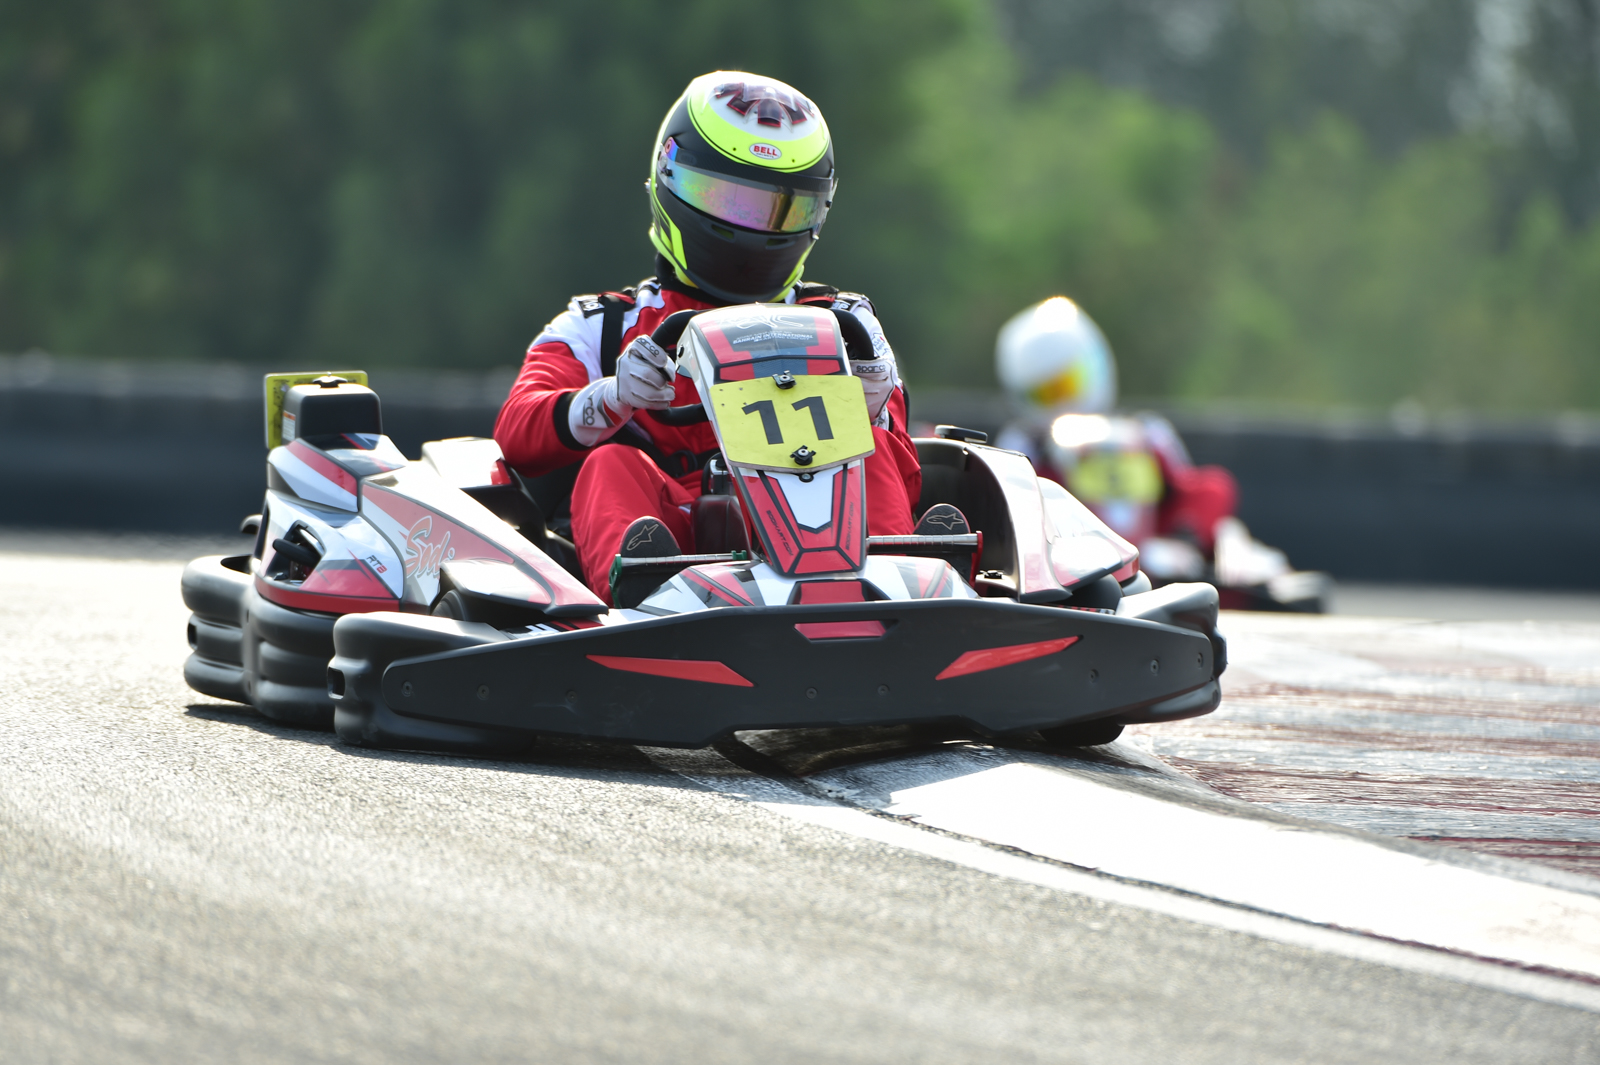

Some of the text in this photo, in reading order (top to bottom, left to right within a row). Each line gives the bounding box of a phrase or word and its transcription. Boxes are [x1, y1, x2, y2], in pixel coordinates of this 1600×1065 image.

[753, 145, 777, 156] BELL
[733, 334, 761, 344] BAHRAIN
[763, 331, 813, 340] INTERNATIONAL
[635, 338, 660, 357] arco
[742, 396, 834, 445] 11
